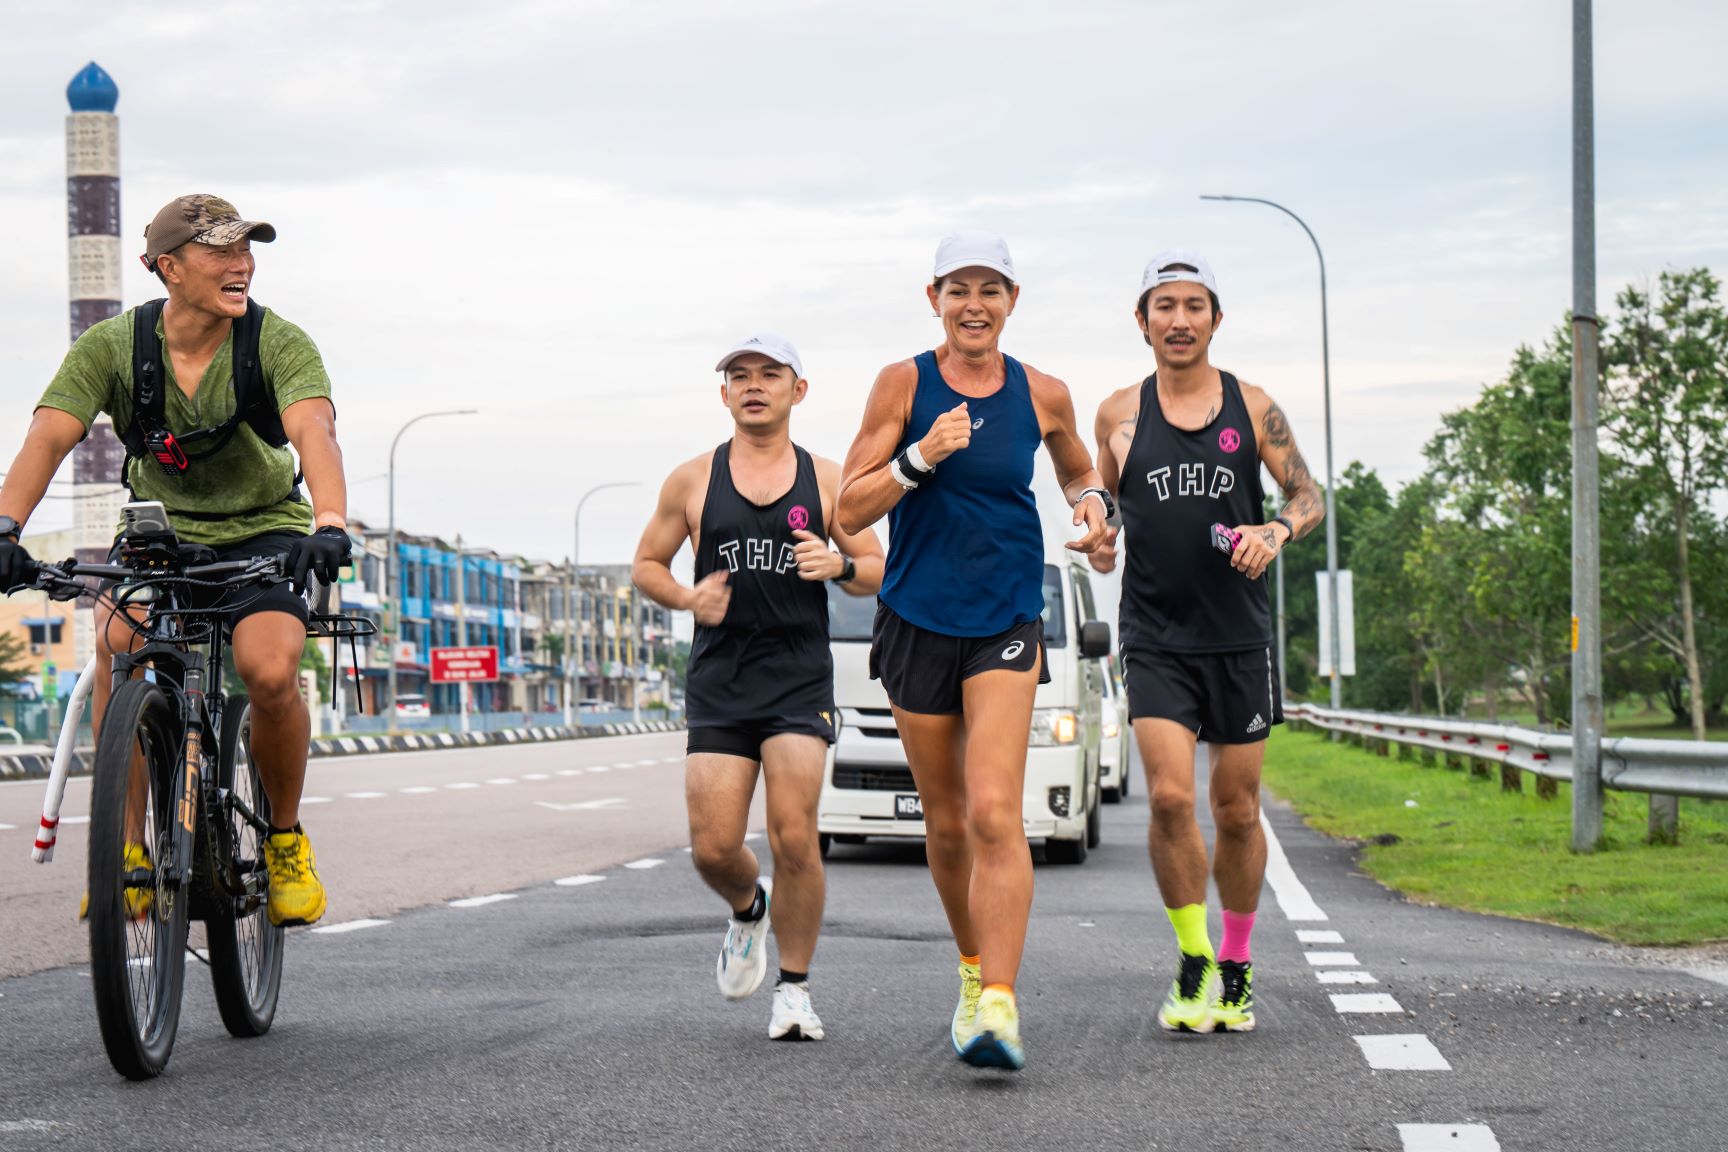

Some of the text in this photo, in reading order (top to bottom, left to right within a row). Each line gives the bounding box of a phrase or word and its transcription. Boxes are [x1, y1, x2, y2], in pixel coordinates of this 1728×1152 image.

[1147, 463, 1235, 502] THP
[718, 538, 799, 575] THP
[1246, 721, 1267, 733] adidas
